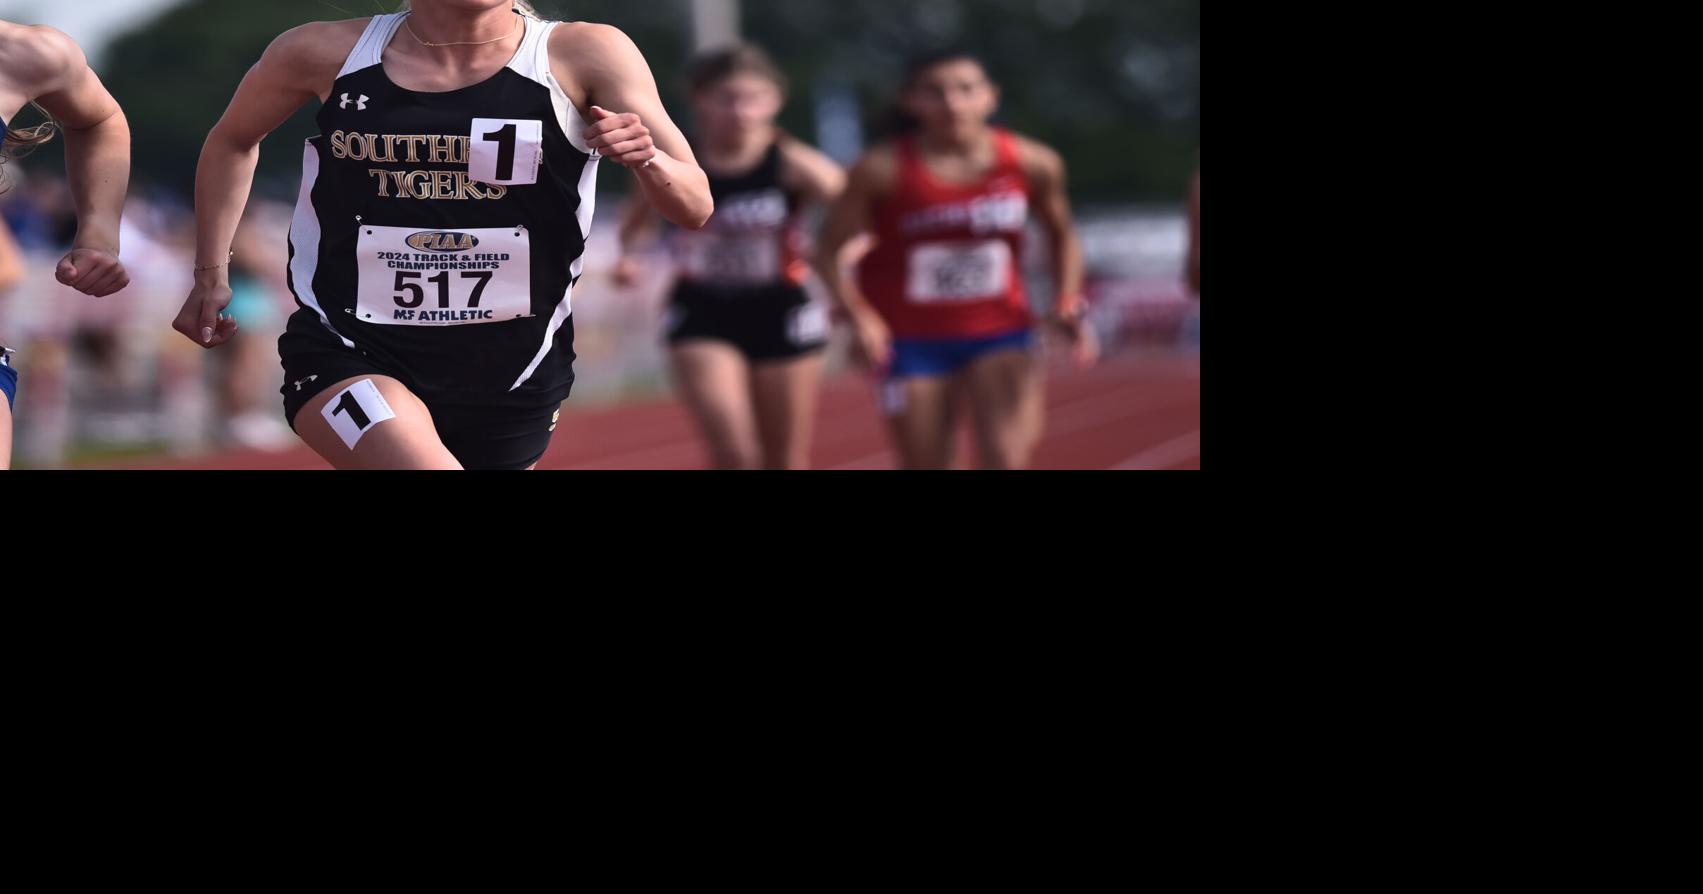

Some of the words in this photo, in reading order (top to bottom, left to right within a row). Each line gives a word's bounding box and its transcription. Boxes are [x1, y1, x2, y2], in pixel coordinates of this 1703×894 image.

[330, 129, 543, 165] SOUTH
[482, 124, 517, 181] 1
[416, 232, 474, 249] PIAA
[377, 251, 410, 261] 2024
[413, 253, 458, 262] TRACK
[461, 254, 471, 262] &
[474, 252, 510, 261] FIELD
[387, 260, 500, 270] CHAMPIONSHIPS
[392, 270, 493, 309] 517
[418, 309, 493, 321] ATHLETIC
[331, 390, 372, 431] 1
